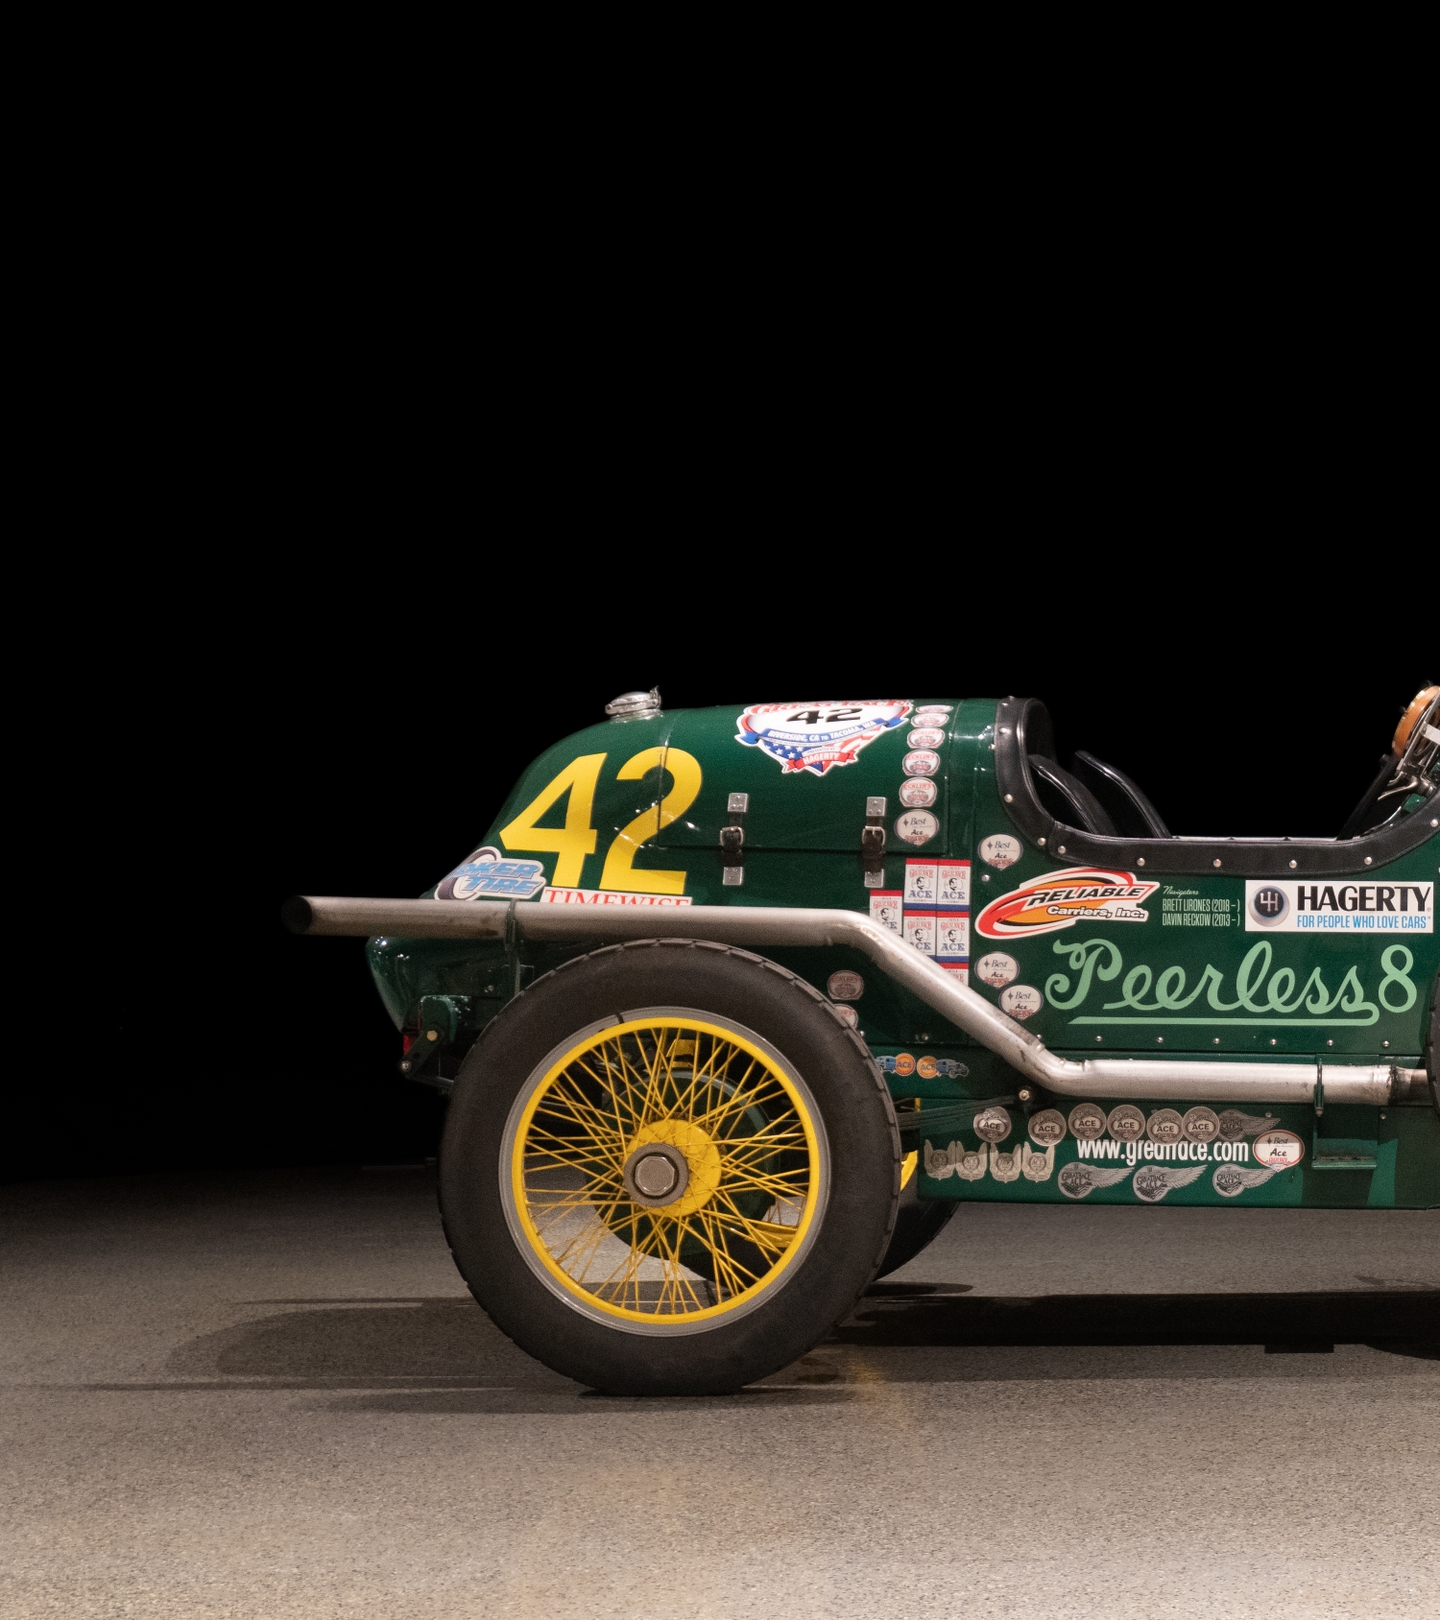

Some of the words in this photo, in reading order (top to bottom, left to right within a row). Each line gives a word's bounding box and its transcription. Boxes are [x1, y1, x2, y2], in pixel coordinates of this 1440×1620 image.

[786, 707, 863, 725] 42
[768, 730, 808, 742] RIVERSIDE,
[809, 733, 820, 742] CA
[829, 725, 863, 739] TACOMA,
[863, 720, 877, 730] WA
[802, 752, 840, 765] HAGERTY
[499, 746, 703, 896] 42
[995, 840, 1011, 849] Best
[446, 861, 540, 880] OKER
[462, 876, 543, 896] TIRE
[908, 890, 933, 899] ACE
[941, 891, 966, 900] ACE
[1028, 885, 1146, 907] RELIABLE
[1162, 885, 1200, 898] Navigators
[1297, 885, 1431, 912] HAGERTY
[1162, 898, 1183, 912] BRETT
[1046, 904, 1113, 919] Carriers,
[1115, 907, 1146, 919] Inc.
[1162, 913, 1183, 926] DAVIN
[1183, 913, 1212, 927] RECKOW
[1297, 914, 1315, 928] FOR
[1317, 914, 1351, 928] PEOPLE
[1353, 915, 1375, 928] WHO
[1377, 915, 1400, 929] LOVE
[941, 942, 966, 952] ACE
[991, 959, 1008, 967] Best
[1044, 938, 1379, 1022] Peerless
[1378, 943, 1418, 1014] 8
[1015, 991, 1032, 1000] Best
[896, 1061, 912, 1069] ACE
[983, 1121, 1001, 1131] ACE
[1078, 1119, 1097, 1128] ACE
[1116, 1121, 1135, 1130] ACE
[1191, 1123, 1210, 1131] ACE
[1038, 1125, 1056, 1133] ACE
[1156, 1125, 1175, 1133] ACE
[1273, 1136, 1289, 1145] Best
[1270, 1147, 1288, 1157] Ace
